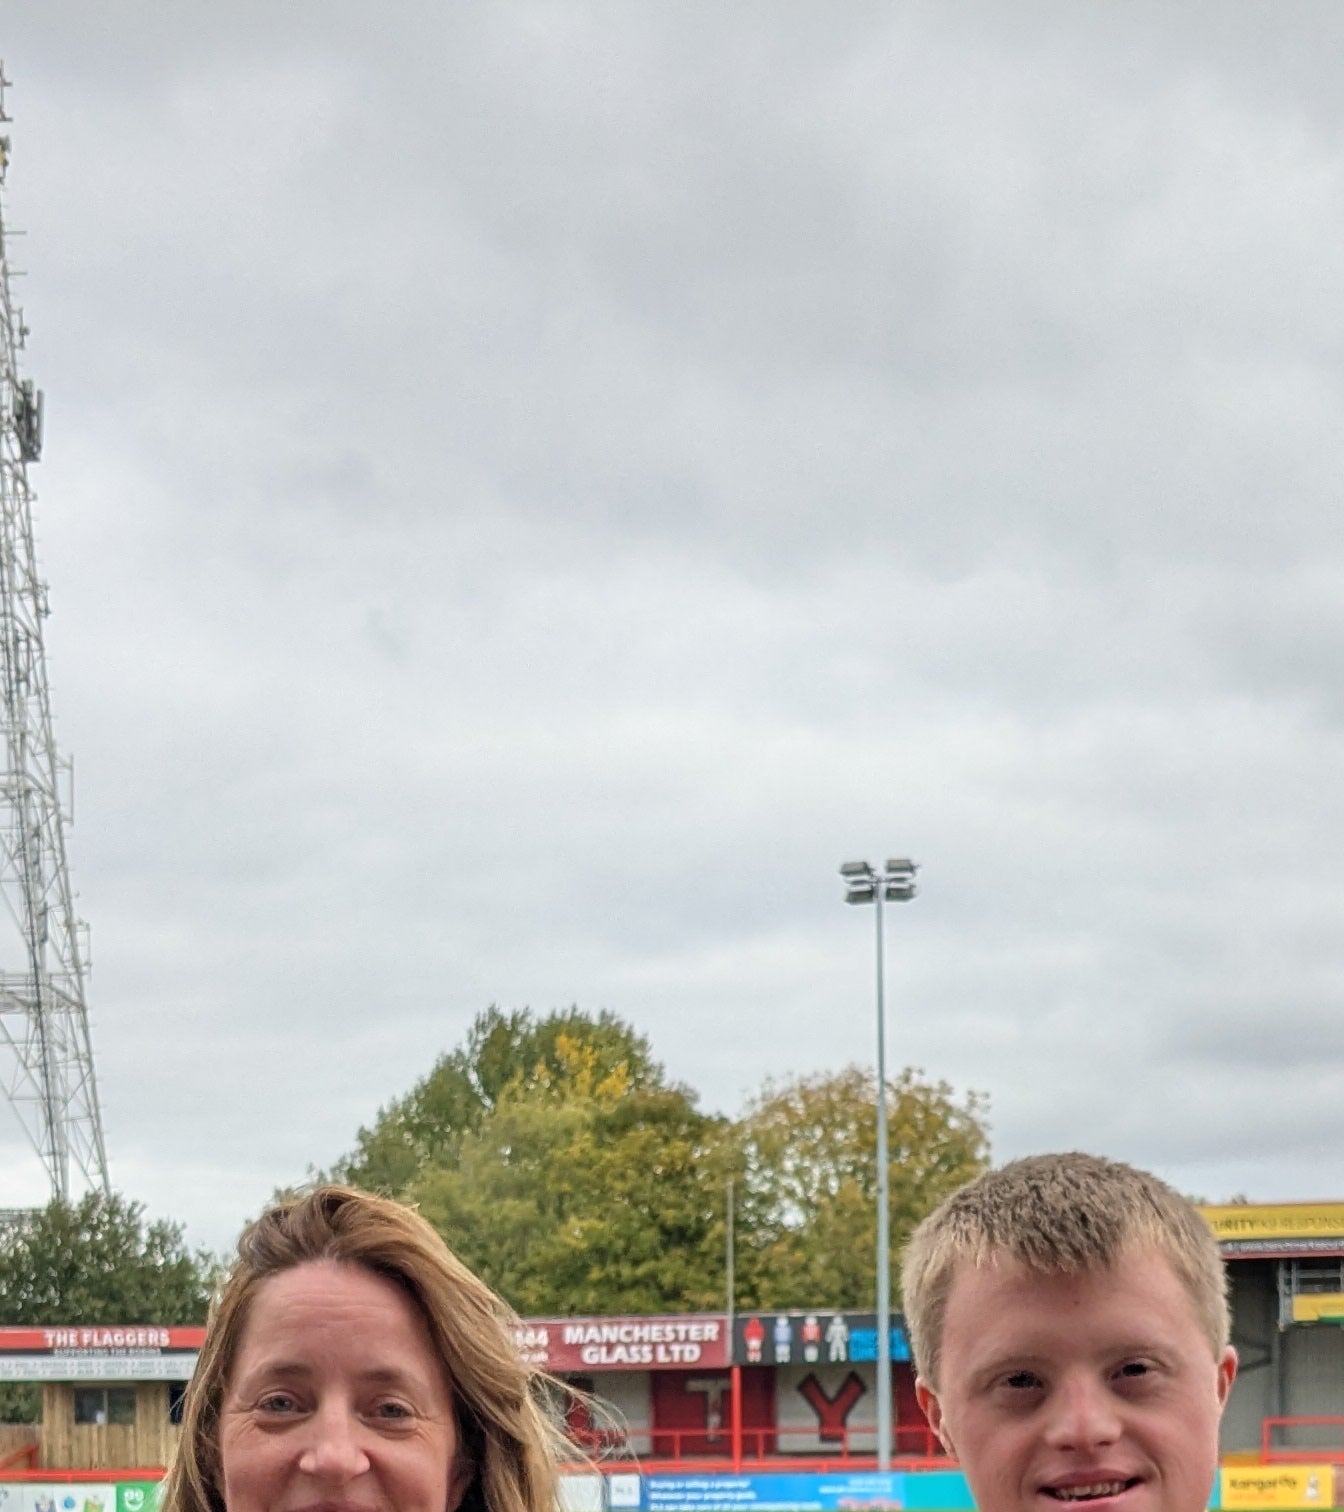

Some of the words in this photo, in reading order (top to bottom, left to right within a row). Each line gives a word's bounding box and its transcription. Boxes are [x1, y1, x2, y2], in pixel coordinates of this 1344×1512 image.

[43, 1329, 79, 1348] THE
[82, 1328, 170, 1348] FLAGGERS
[564, 1322, 720, 1345] MANCHESTER
[580, 1344, 654, 1364] GLASS
[657, 1344, 701, 1363] LTD
